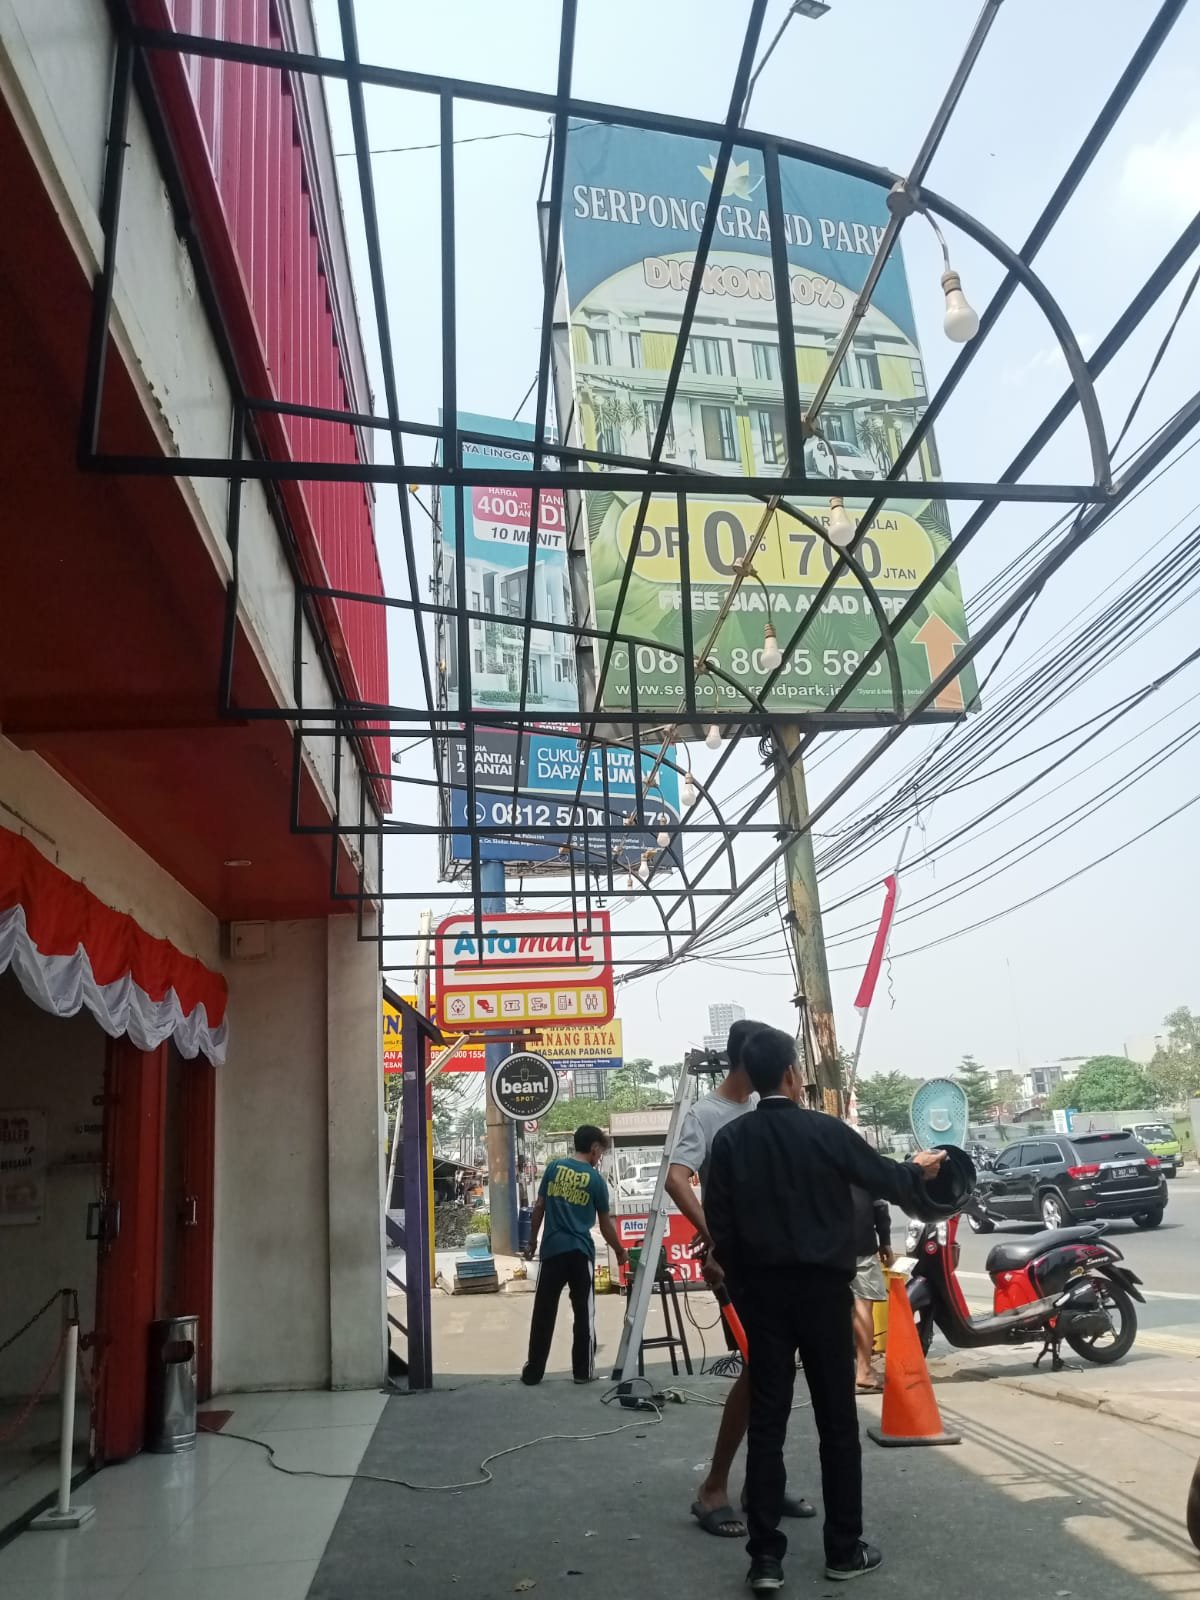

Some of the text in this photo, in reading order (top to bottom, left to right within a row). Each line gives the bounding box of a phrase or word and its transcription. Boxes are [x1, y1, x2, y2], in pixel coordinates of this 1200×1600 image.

[573, 184, 707, 233] SERPONG
[717, 204, 813, 247] GRAND
[643, 257, 845, 309] DISKON 0%
[483, 447, 530, 462] LINGGA
[477, 495, 518, 518] 400
[491, 527, 562, 547] 10 MNIT
[884, 567, 917, 580] JTAN
[636, 646, 721, 674] 085
[475, 752, 512, 765] ANTAI
[592, 752, 599, 765] 1
[457, 763, 513, 775] 2 ANTAI
[491, 802, 552, 827] 0812
[584, 1032, 616, 1046] RAYA
[579, 1047, 612, 1056] PADANG
[501, 1076, 549, 1094] bean!
[555, 1165, 590, 1190] TIRED
